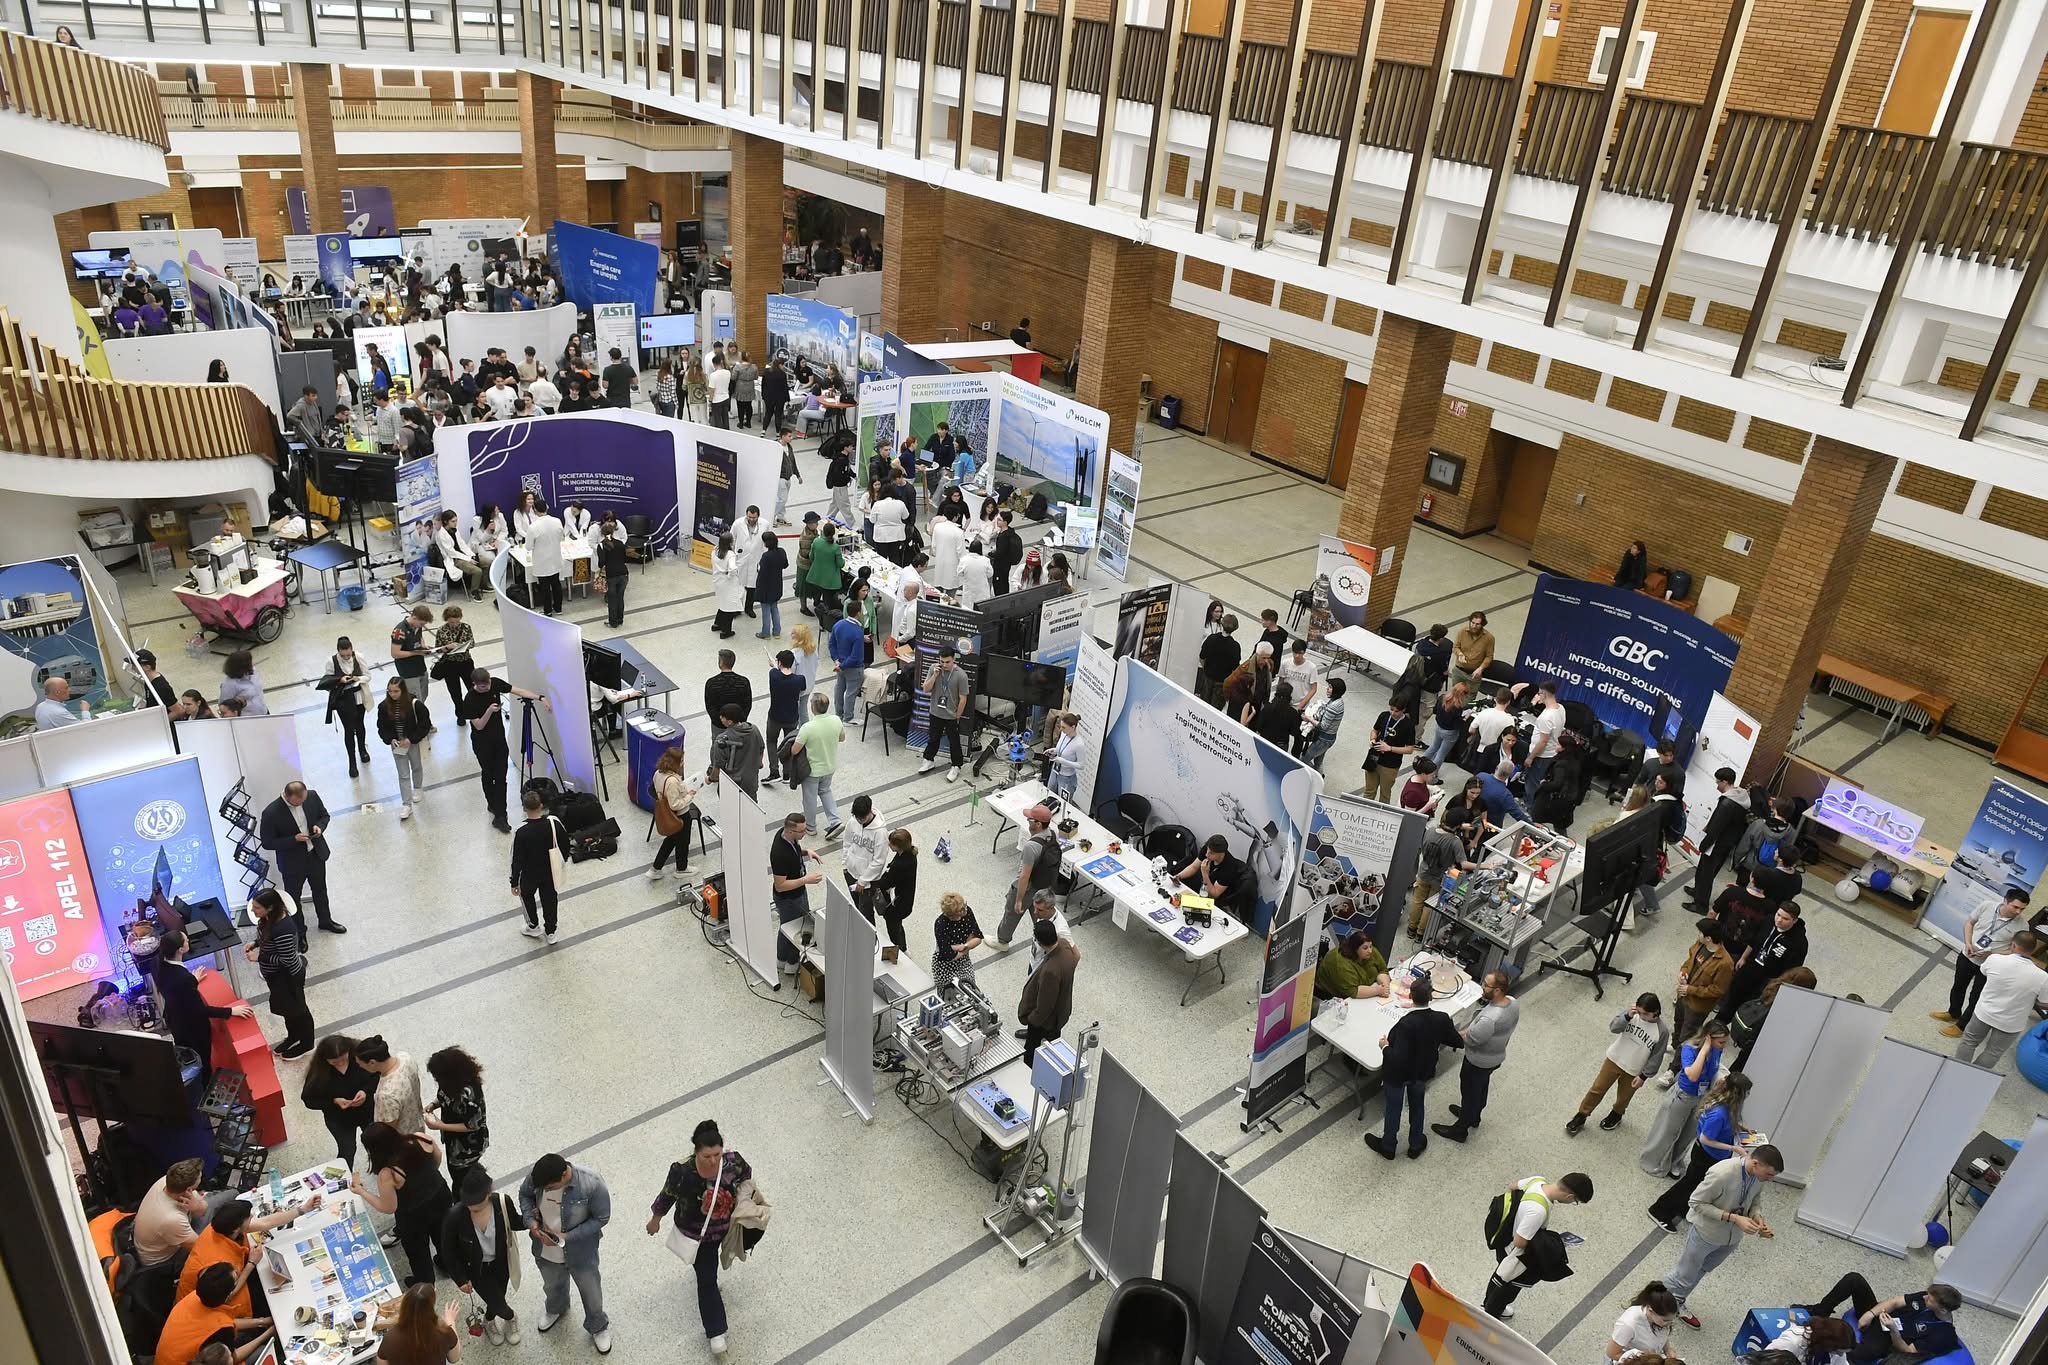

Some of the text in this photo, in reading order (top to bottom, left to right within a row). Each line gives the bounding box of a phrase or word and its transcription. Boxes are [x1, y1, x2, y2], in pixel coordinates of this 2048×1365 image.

[589, 258, 622, 275] Energia care
[872, 383, 898, 393] HOLCIM
[911, 380, 983, 391] CONSTRUIM VIITORUL
[919, 388, 951, 397] ARMONIE
[961, 386, 989, 394] NATURA
[1074, 414, 1102, 430] HOLCIM
[558, 472, 594, 480] SOCIETATEA
[600, 479, 625, 487] CHIMICĂ
[922, 631, 955, 642] MASTER
[1608, 635, 1664, 671] GBC
[1568, 652, 1631, 682] INTEGRATED
[1524, 655, 1656, 717] Making a differen
[1175, 712, 1208, 738] Inginerie
[1208, 734, 1243, 761] Mecanică
[1187, 708, 1241, 748] Youth in Action
[1189, 732, 1233, 766] Mecatronică
[1314, 804, 1399, 834] OPTOMETRIE
[1983, 814, 2016, 836] Applications
[1987, 806, 2045, 841] Solutions for Leading
[1991, 799, 2019, 817] Advanced
[2026, 817, 2048, 832] Optical
[1341, 836, 1353, 845] DIN
[1343, 830, 1386, 846] POLITEHNICA
[1344, 824, 1394, 842] UNIVERSITATEA
[44, 837, 84, 920] APEL 112
[1270, 936, 1291, 954] DESIGN
[1263, 1293, 1310, 1347] PoliFest
